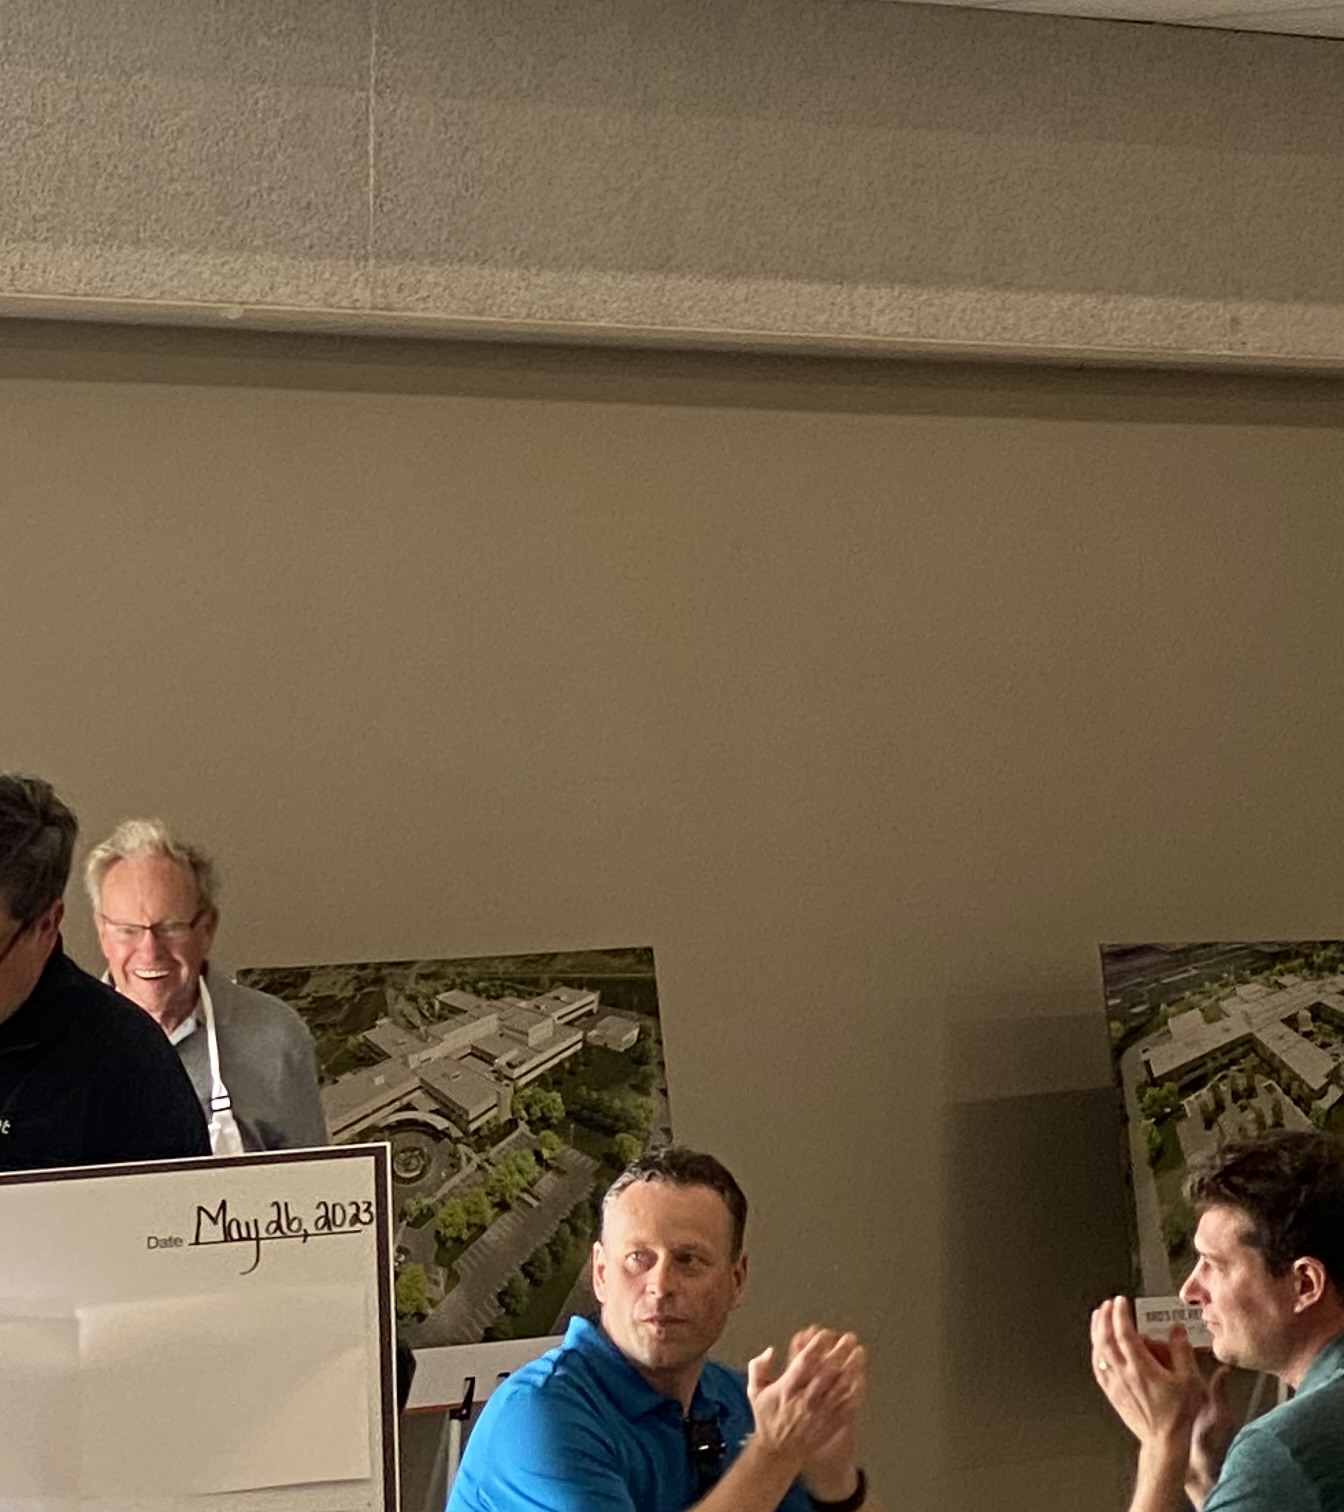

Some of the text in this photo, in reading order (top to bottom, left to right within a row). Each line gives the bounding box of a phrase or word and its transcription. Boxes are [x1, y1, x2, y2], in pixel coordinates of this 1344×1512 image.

[147, 1235, 183, 1250] Date
[195, 1199, 261, 1275] May
[314, 1200, 374, 1231] 2023
